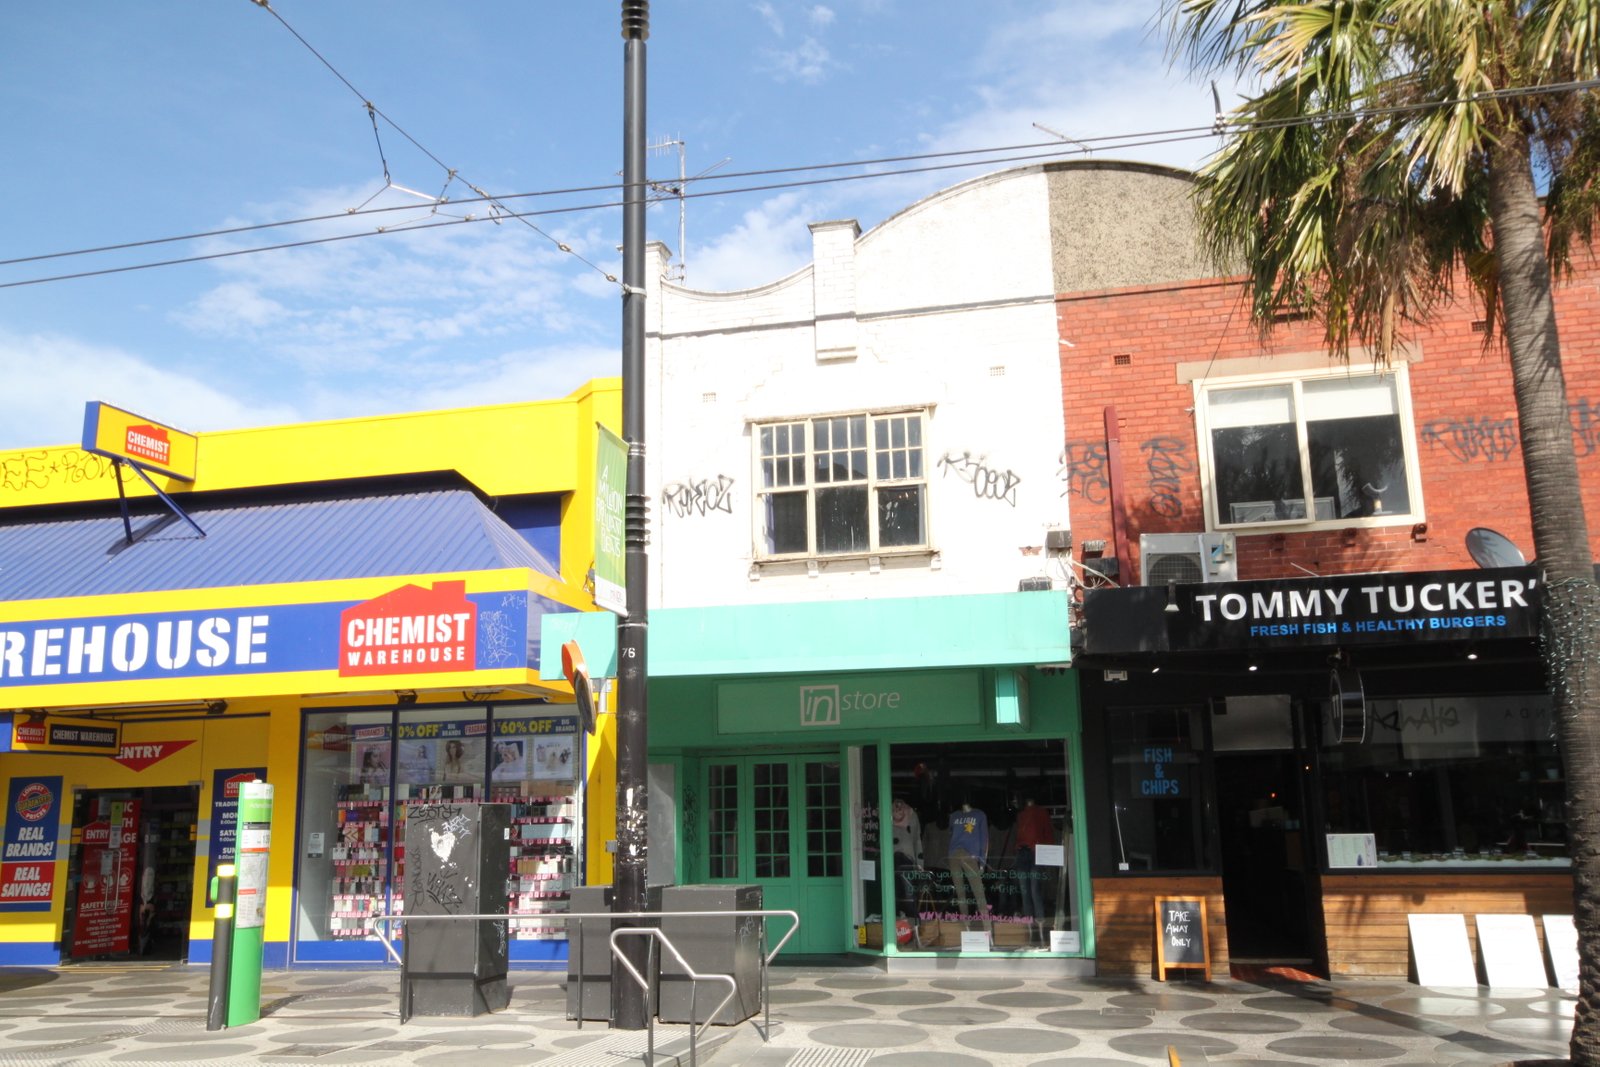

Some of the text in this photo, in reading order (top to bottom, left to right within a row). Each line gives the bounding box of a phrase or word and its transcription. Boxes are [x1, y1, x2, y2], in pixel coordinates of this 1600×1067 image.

[128, 431, 169, 454] CHEMIST
[1195, 578, 1537, 621] TOMMY TUCKER'
[347, 613, 470, 647] CHEMIST
[1250, 615, 1506, 637] FRESH FISH & HEALTHY BURGERS
[0, 615, 269, 678] REHOUSE
[622, 647, 636, 658] 76
[348, 647, 465, 666] WAREHOUSE
[842, 686, 900, 710] store
[416, 724, 439, 737] OFF
[500, 720, 527, 734] 60%
[528, 719, 552, 733] OFF
[52, 729, 79, 741] CHEMIST
[80, 731, 114, 743] WAREHOUSE
[1144, 748, 1173, 763] FISH
[1155, 764, 1165, 779] &
[1142, 779, 1180, 795] CHIPS
[18, 827, 44, 840] REAL
[86, 829, 110, 839] ENTRY
[5, 841, 54, 857] BRANDS!
[13, 866, 40, 881] REAL
[1, 882, 51, 897] SAVINGS!
[1168, 910, 1191, 923] TAKE
[1165, 923, 1188, 936] AWAY
[1171, 936, 1191, 948] ONLY
